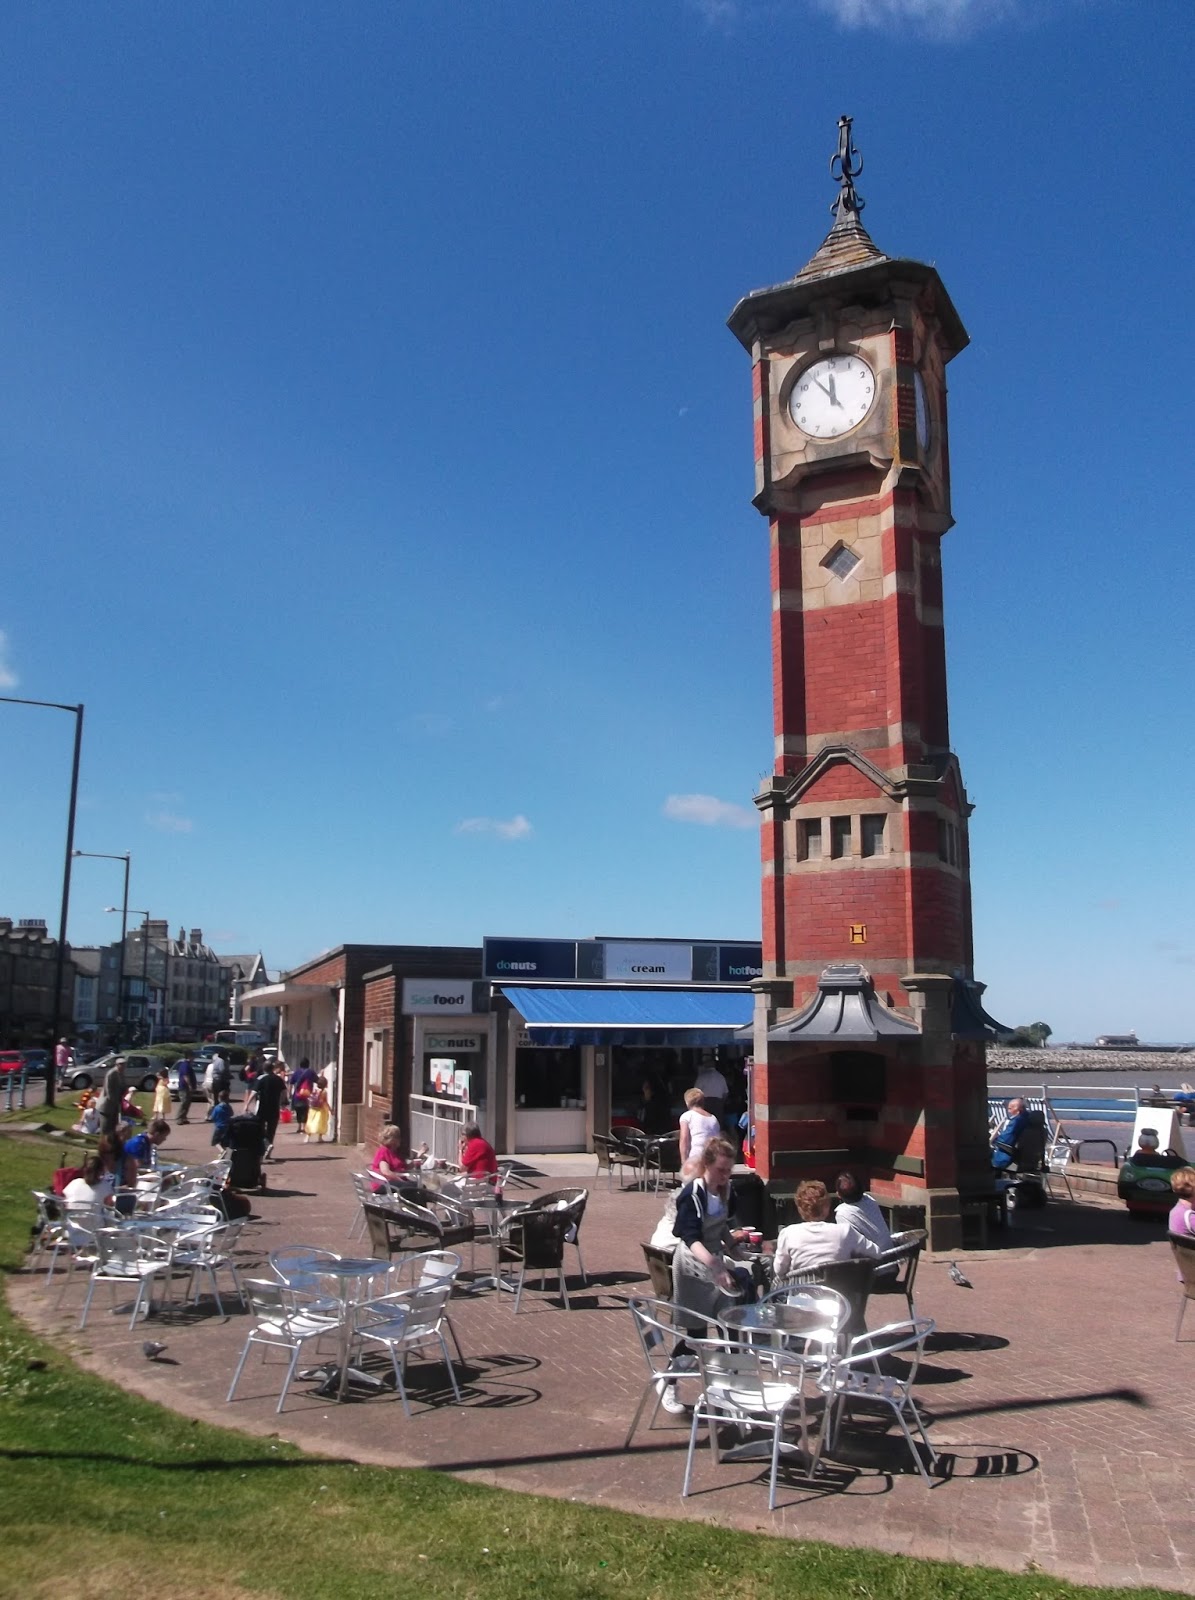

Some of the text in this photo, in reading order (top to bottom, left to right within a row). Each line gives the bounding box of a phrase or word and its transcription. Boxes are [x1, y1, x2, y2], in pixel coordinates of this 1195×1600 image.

[828, 361, 836, 370] 12
[800, 384, 809, 392] 10
[801, 416, 807, 424] 8
[496, 960, 537, 970] donuts
[631, 964, 666, 973] cream
[728, 965, 763, 976] hotfoo
[410, 994, 465, 1005] Seafood
[428, 1037, 476, 1048] Donuts
